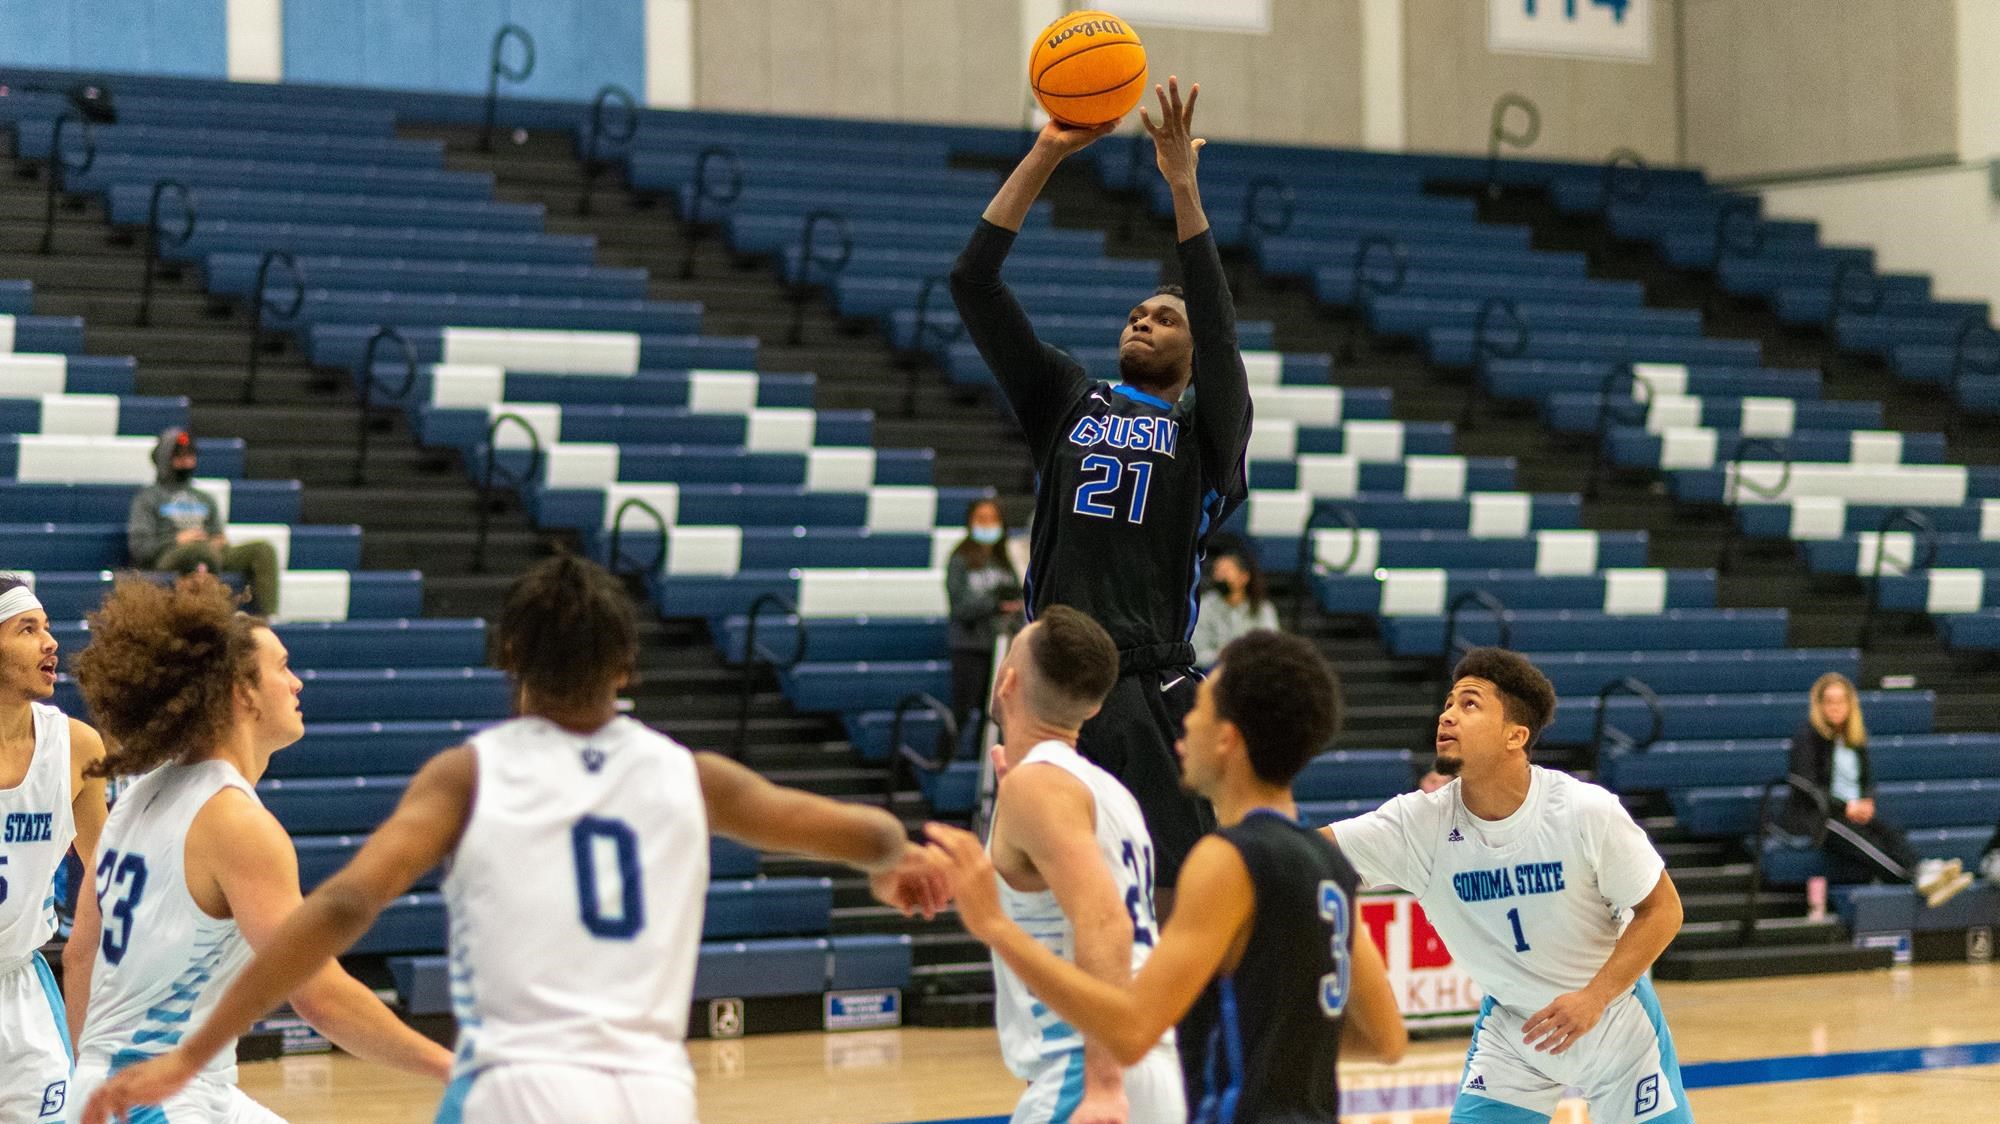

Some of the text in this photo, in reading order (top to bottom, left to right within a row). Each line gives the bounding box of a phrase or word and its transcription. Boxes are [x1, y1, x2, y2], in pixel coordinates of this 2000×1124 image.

[1047, 20, 1126, 49] Wilson
[1073, 453, 1153, 524] 21
[4, 812, 53, 843] STATE
[571, 812, 645, 941] 0
[1452, 861, 1566, 902] SONOMA STATE
[1317, 879, 1352, 1018] 3
[1506, 907, 1531, 953] 1
[1634, 1073, 1659, 1117] S
